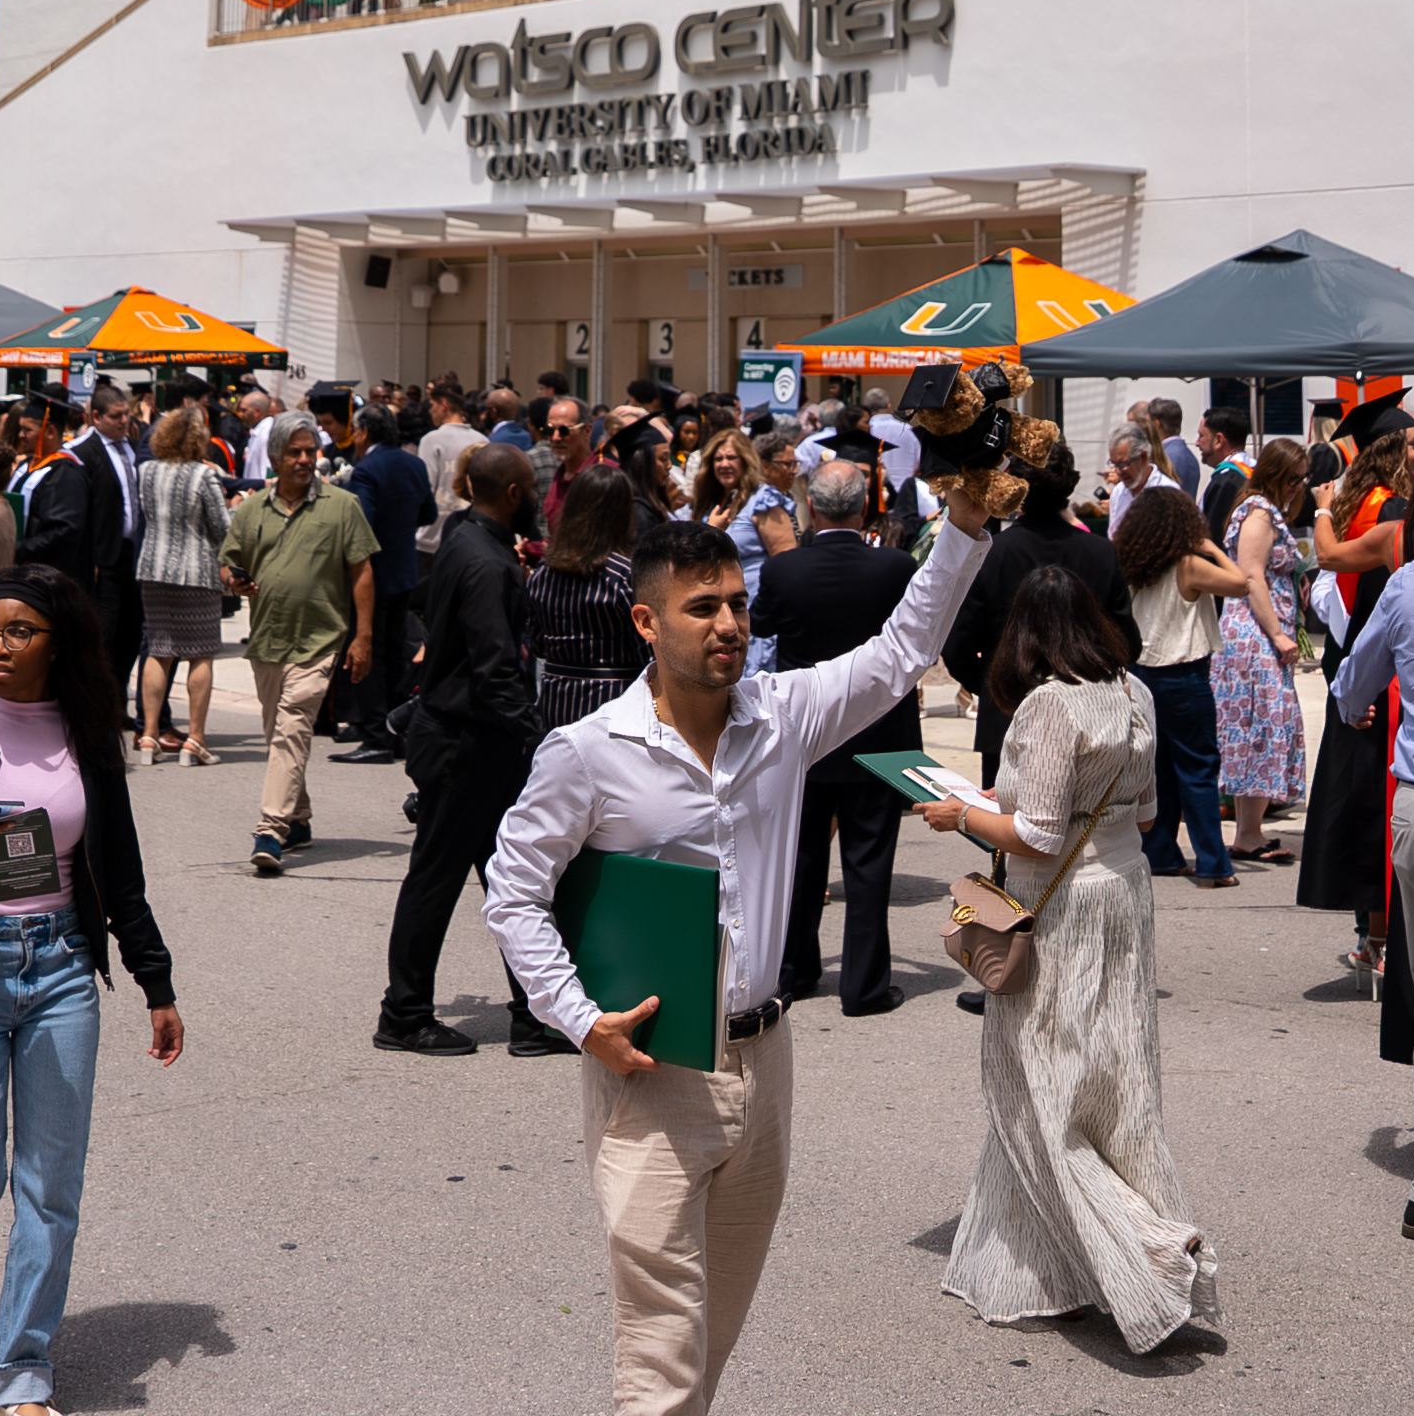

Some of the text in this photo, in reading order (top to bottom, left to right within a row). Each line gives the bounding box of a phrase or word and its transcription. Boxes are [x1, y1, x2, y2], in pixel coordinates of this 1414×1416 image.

[463, 69, 872, 148] UNIVERSITY OF MIAMI
[487, 148, 578, 182] CORAL
[701, 122, 839, 165] FLORIDA
[705, 268, 785, 285] CKETS
[575, 323, 590, 355] 2
[659, 322, 673, 355] 3
[746, 320, 763, 350] 4
[821, 350, 866, 369] MIAMI
